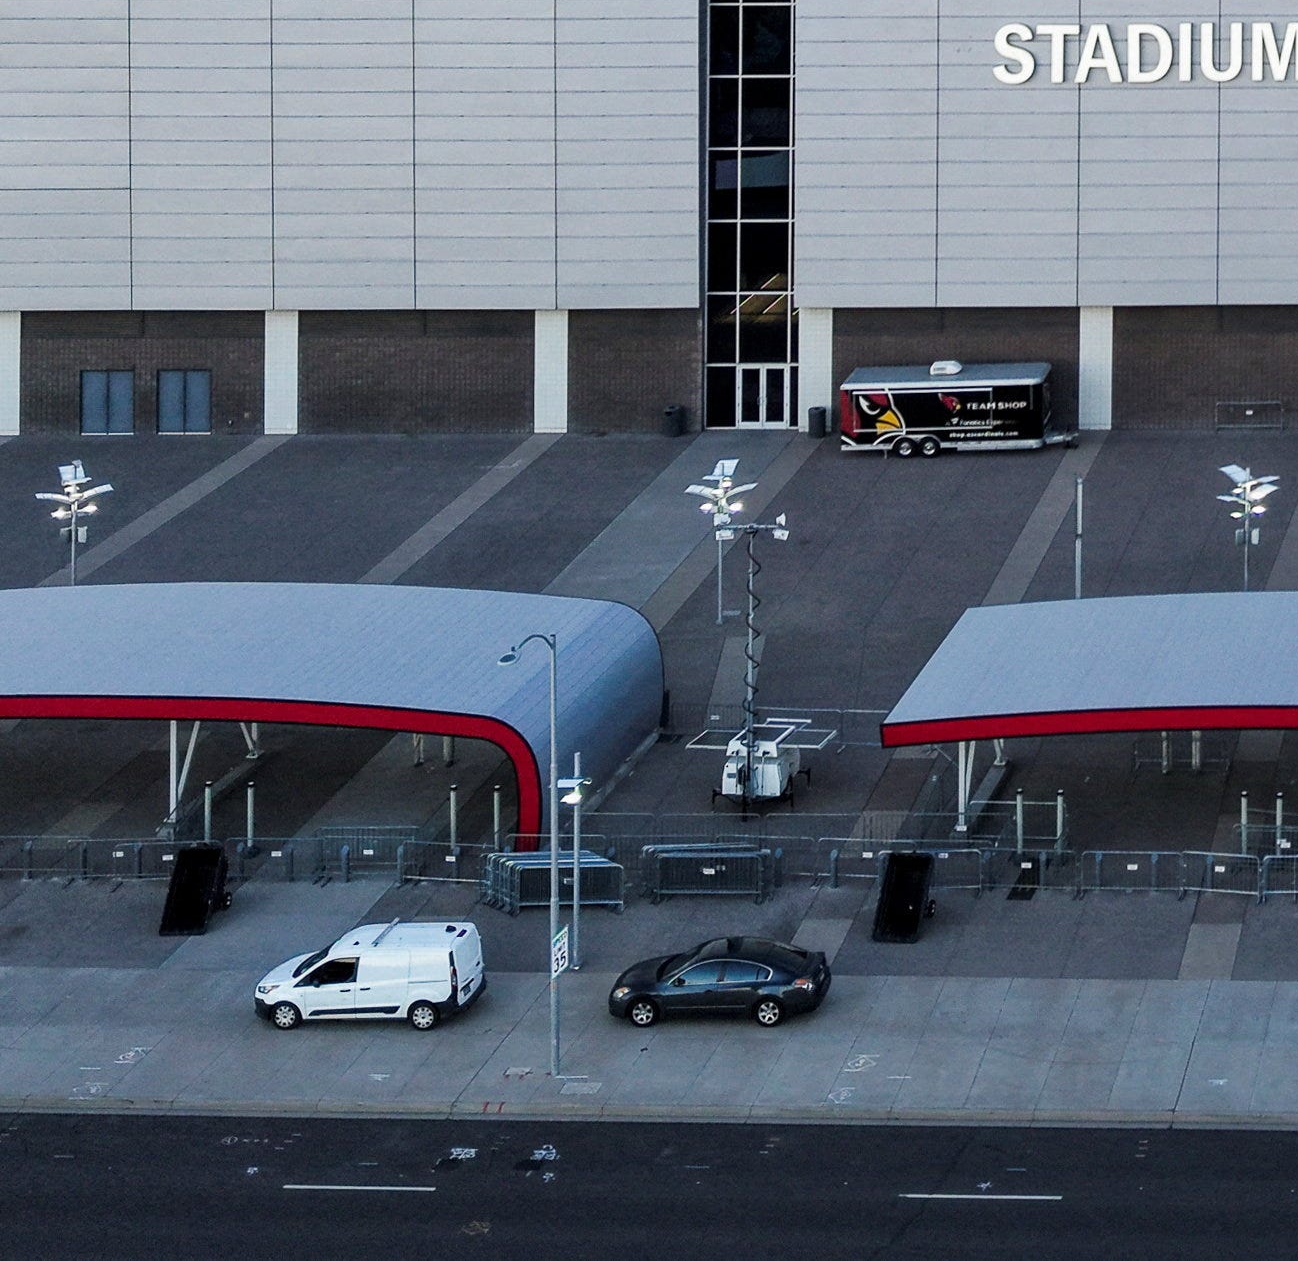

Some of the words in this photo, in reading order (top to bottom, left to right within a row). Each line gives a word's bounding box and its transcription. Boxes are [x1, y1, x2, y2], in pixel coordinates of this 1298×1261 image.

[966, 402, 996, 410] TEAM
[997, 401, 1027, 410] SHOP
[554, 950, 566, 973] 35
